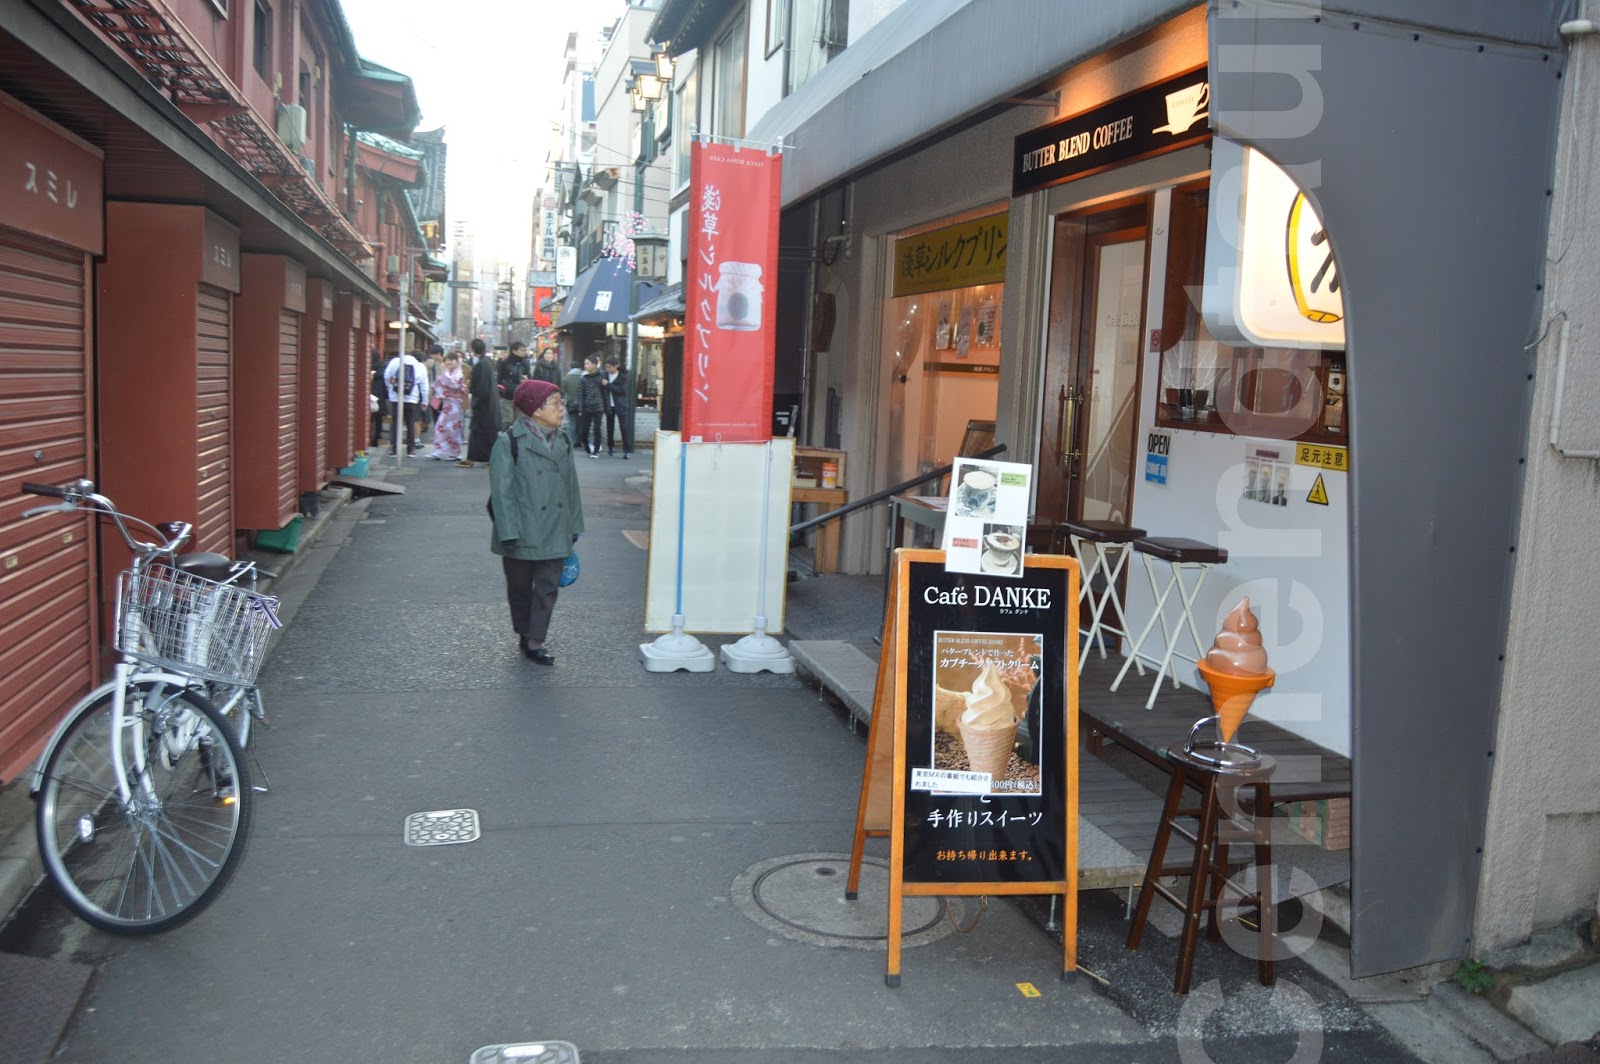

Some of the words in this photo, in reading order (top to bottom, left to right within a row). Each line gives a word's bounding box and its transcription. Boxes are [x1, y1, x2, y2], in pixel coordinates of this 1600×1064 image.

[1022, 144, 1055, 173] BUTTER
[1058, 131, 1090, 162] BLEND
[1093, 115, 1133, 150] COFFEE
[1148, 433, 1170, 455] OPEN
[1300, 447, 1344, 467] 足元注意
[924, 586, 968, 605] Café
[974, 586, 1051, 609] DANKE
[915, 780, 938, 789] れました
[926, 809, 1043, 828] 手作りスイーツ
[936, 850, 1033, 862] お持ち帰り出来ます。
